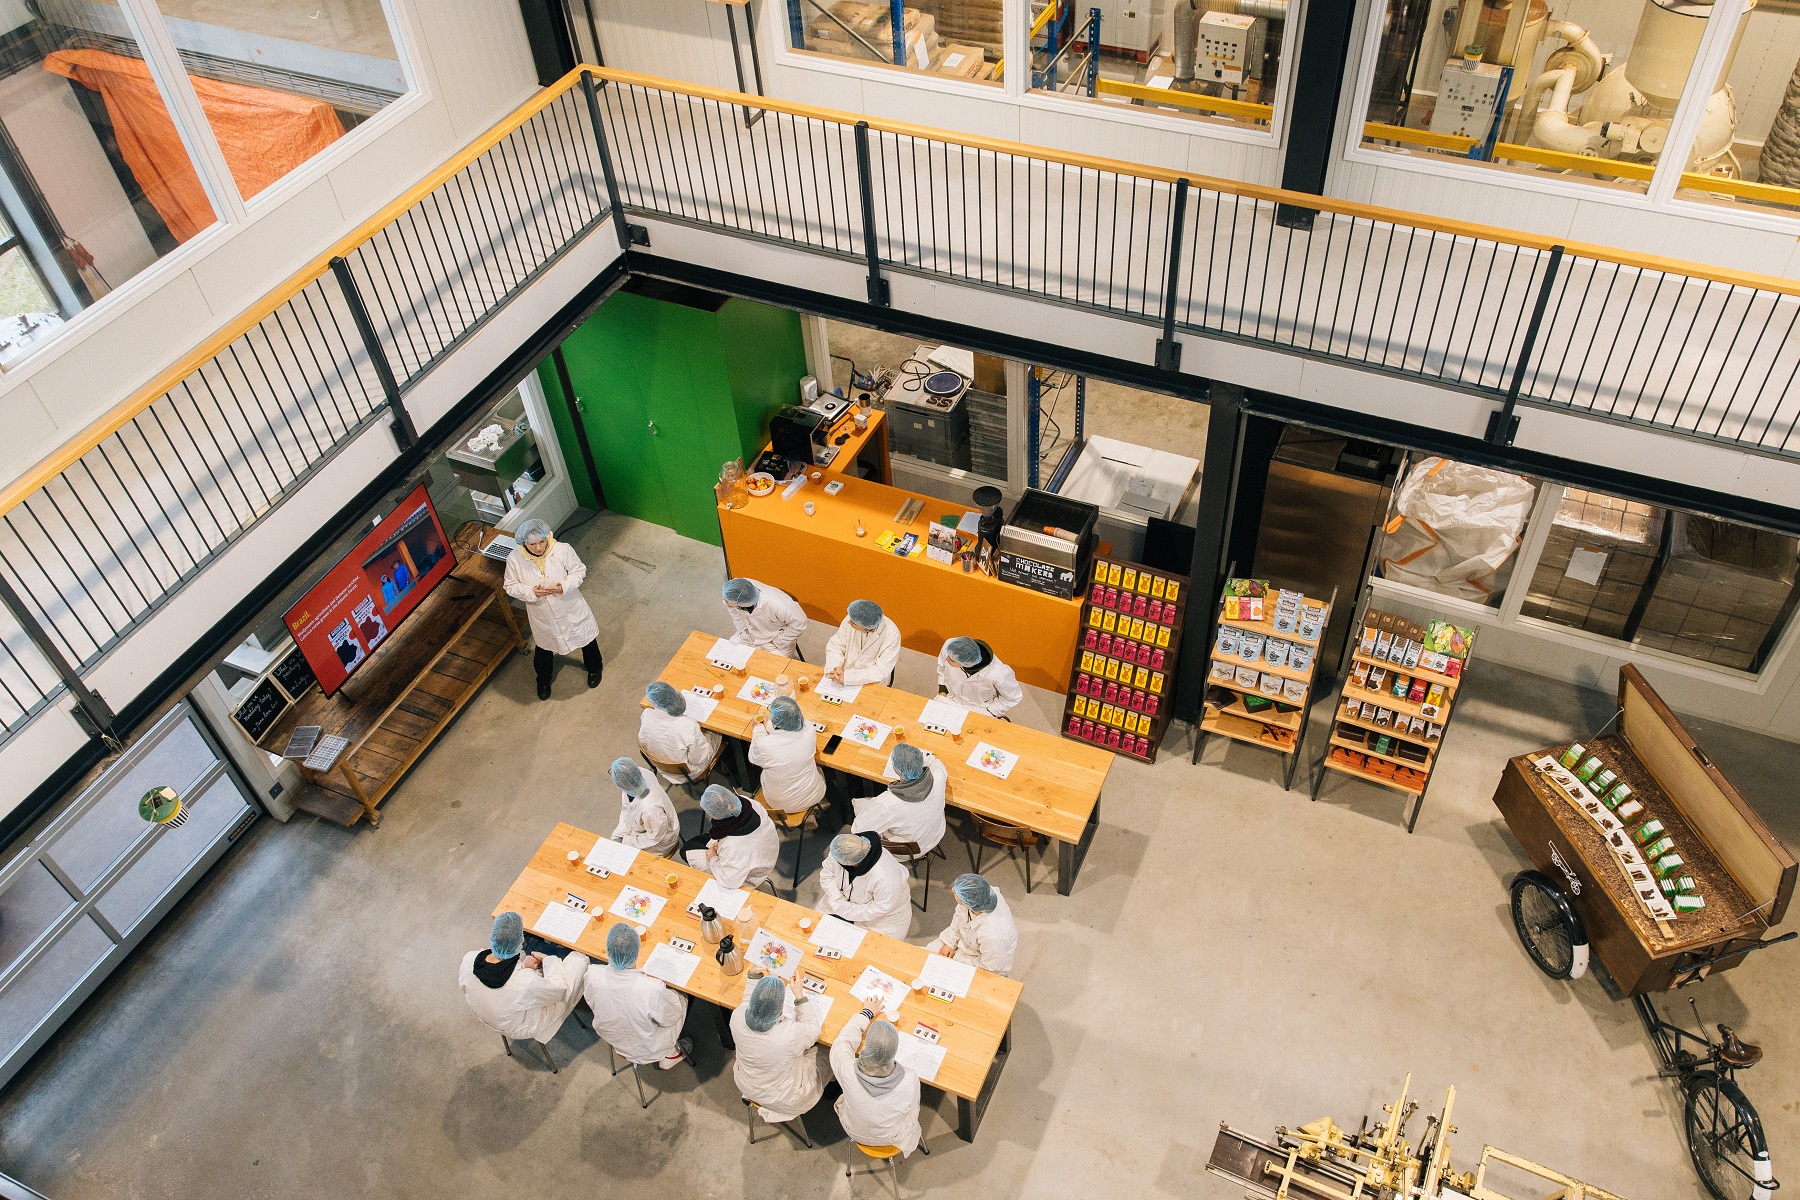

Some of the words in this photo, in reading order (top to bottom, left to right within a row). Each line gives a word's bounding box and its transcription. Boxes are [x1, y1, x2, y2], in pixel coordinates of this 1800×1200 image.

[1016, 557, 1055, 572] CHOCOLATE
[1016, 563, 1053, 578] MAKERS
[274, 663, 288, 677] What
[235, 707, 247, 720] What
